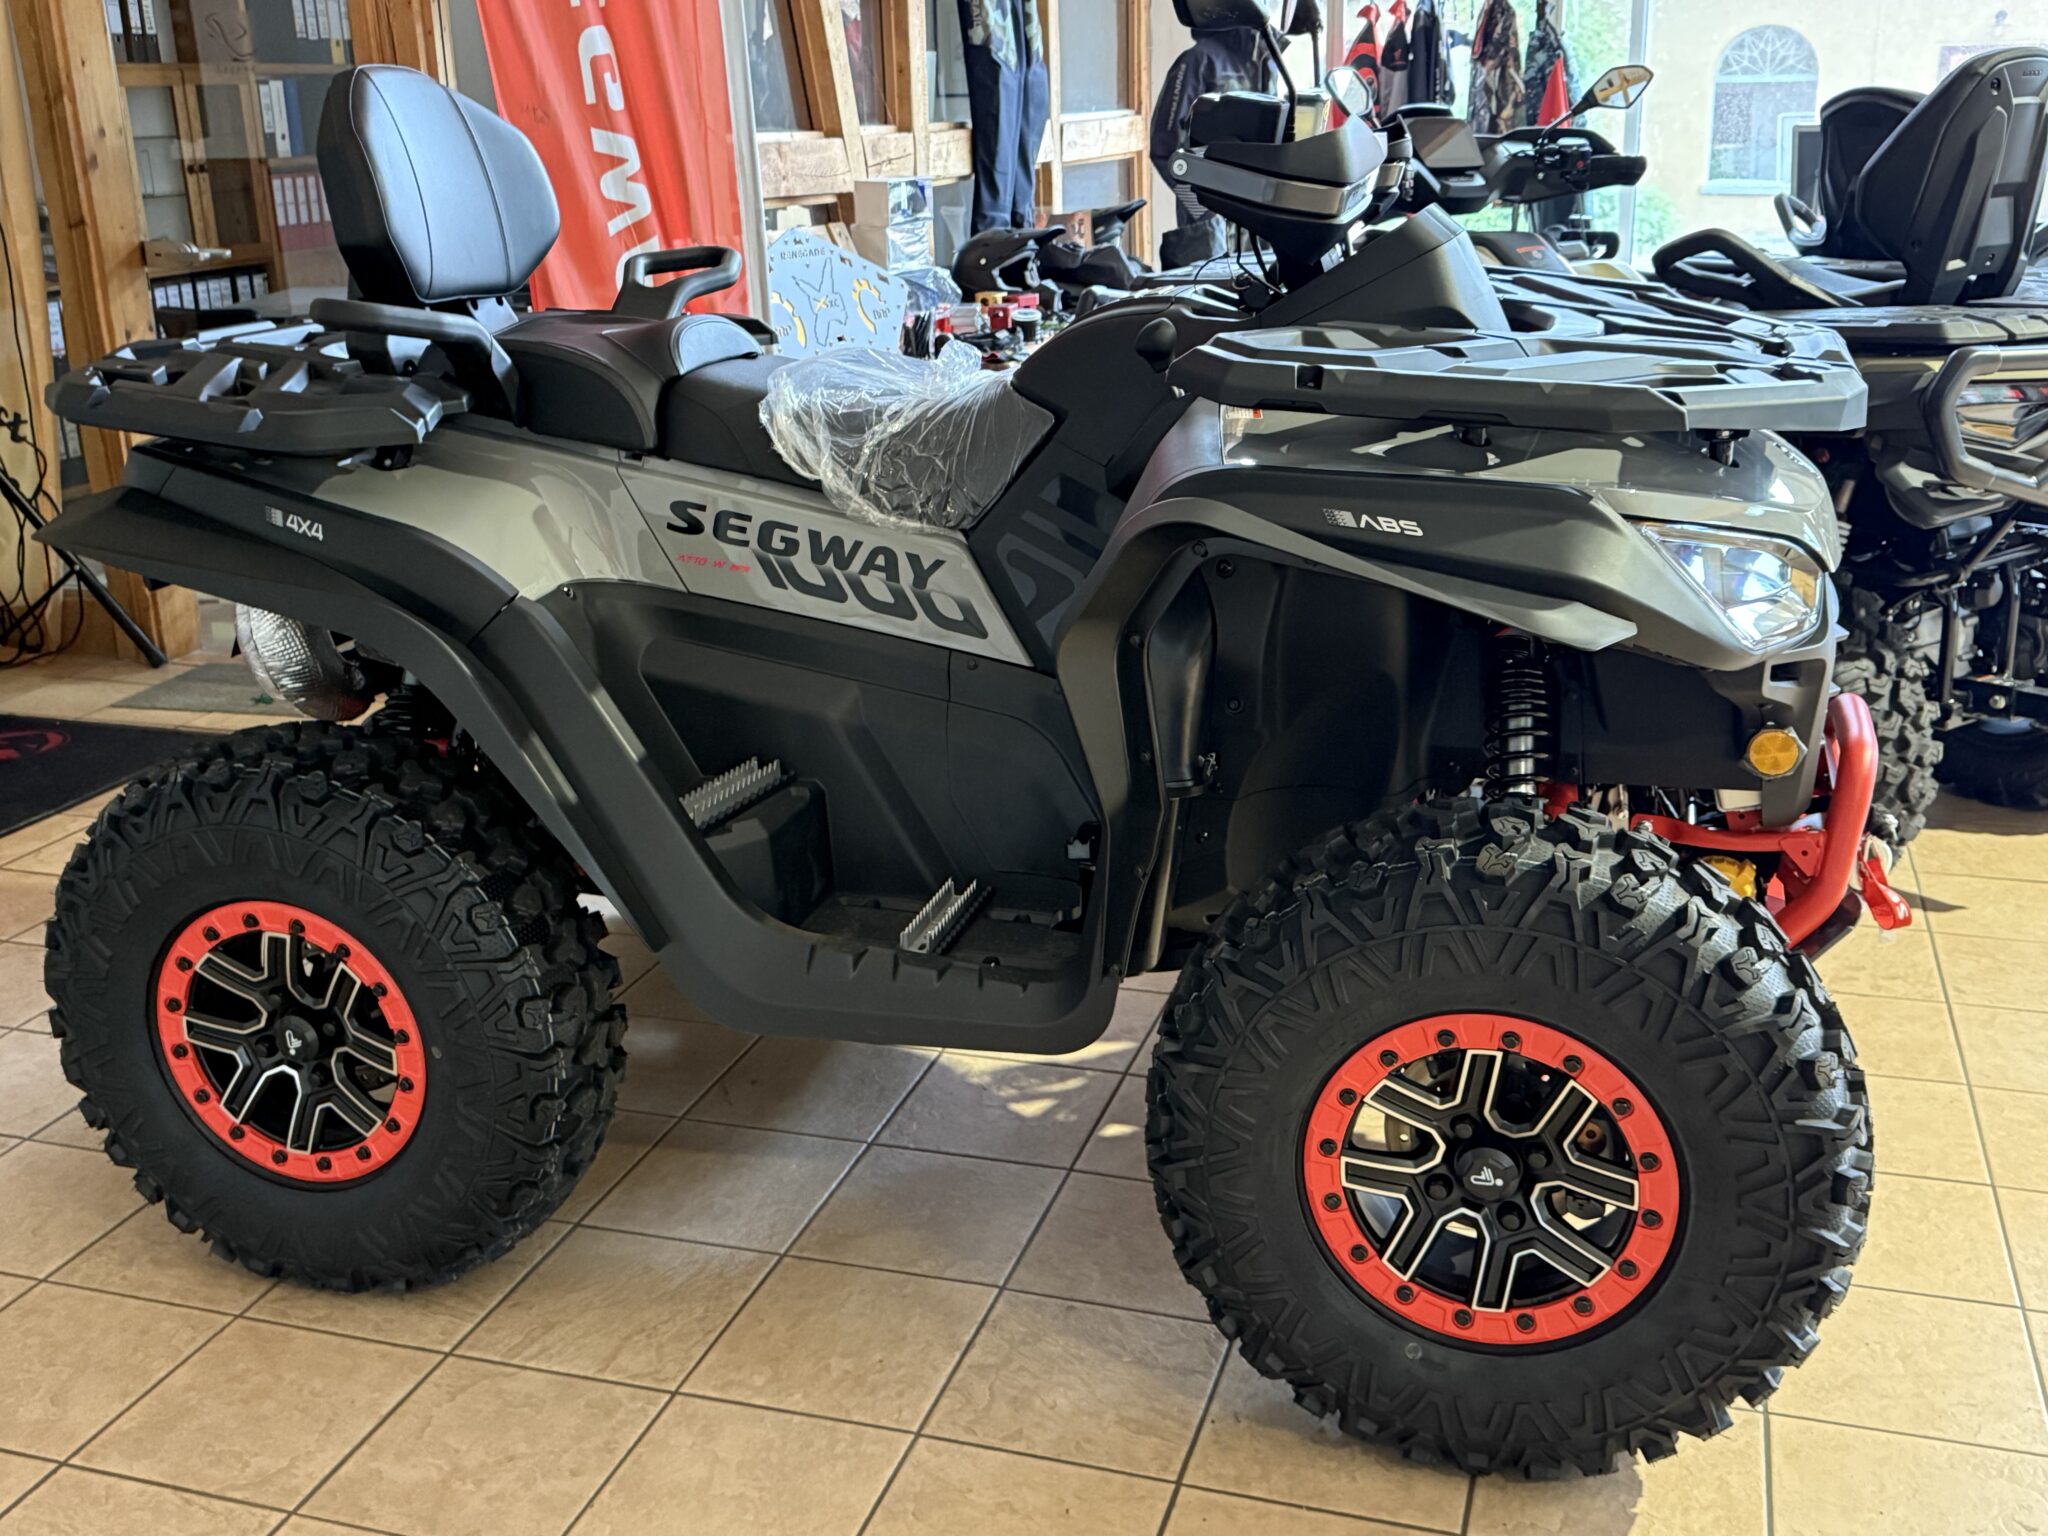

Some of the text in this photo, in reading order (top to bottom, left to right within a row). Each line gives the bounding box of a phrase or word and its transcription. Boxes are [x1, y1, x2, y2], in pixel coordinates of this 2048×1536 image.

[780, 247, 826, 260] RENEGADE
[1360, 514, 1424, 536] ABS
[666, 500, 946, 590] SEGWAY
